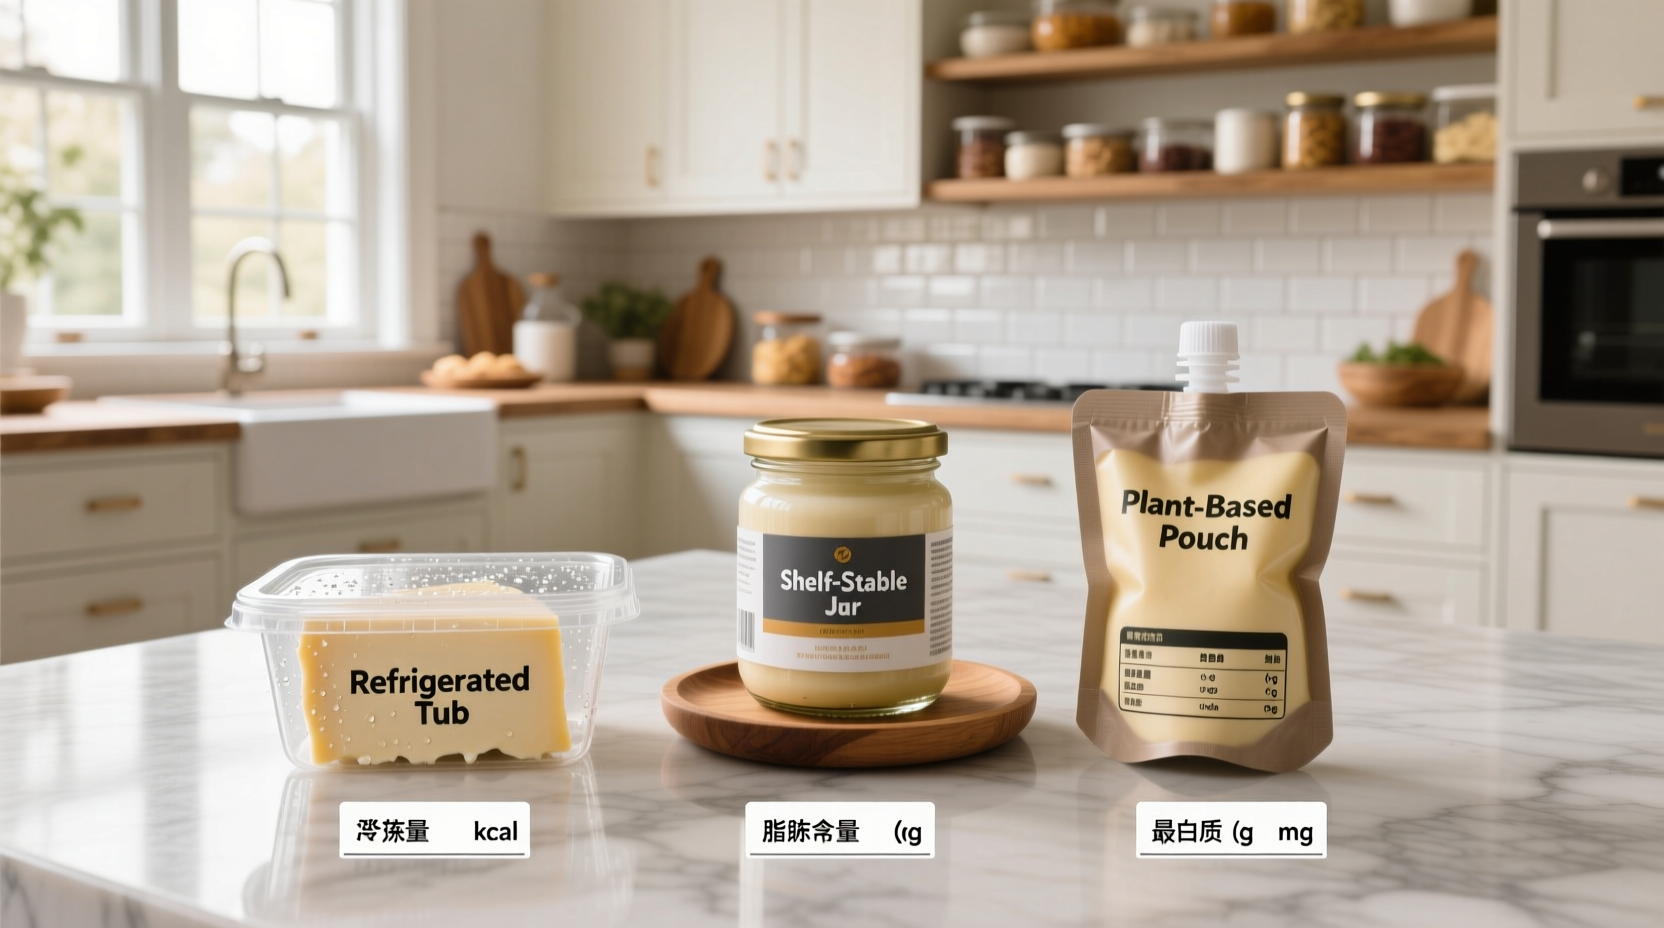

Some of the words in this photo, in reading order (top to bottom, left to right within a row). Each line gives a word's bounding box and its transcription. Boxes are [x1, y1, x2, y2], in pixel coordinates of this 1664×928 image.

[1121, 489, 1292, 520] Plant-Based
[1159, 524, 1248, 551] Pouch
[780, 569, 908, 592] Shelf-Stable
[825, 596, 862, 616] Jar
[350, 665, 530, 699] Refrigerated
[414, 700, 470, 726] Tub
